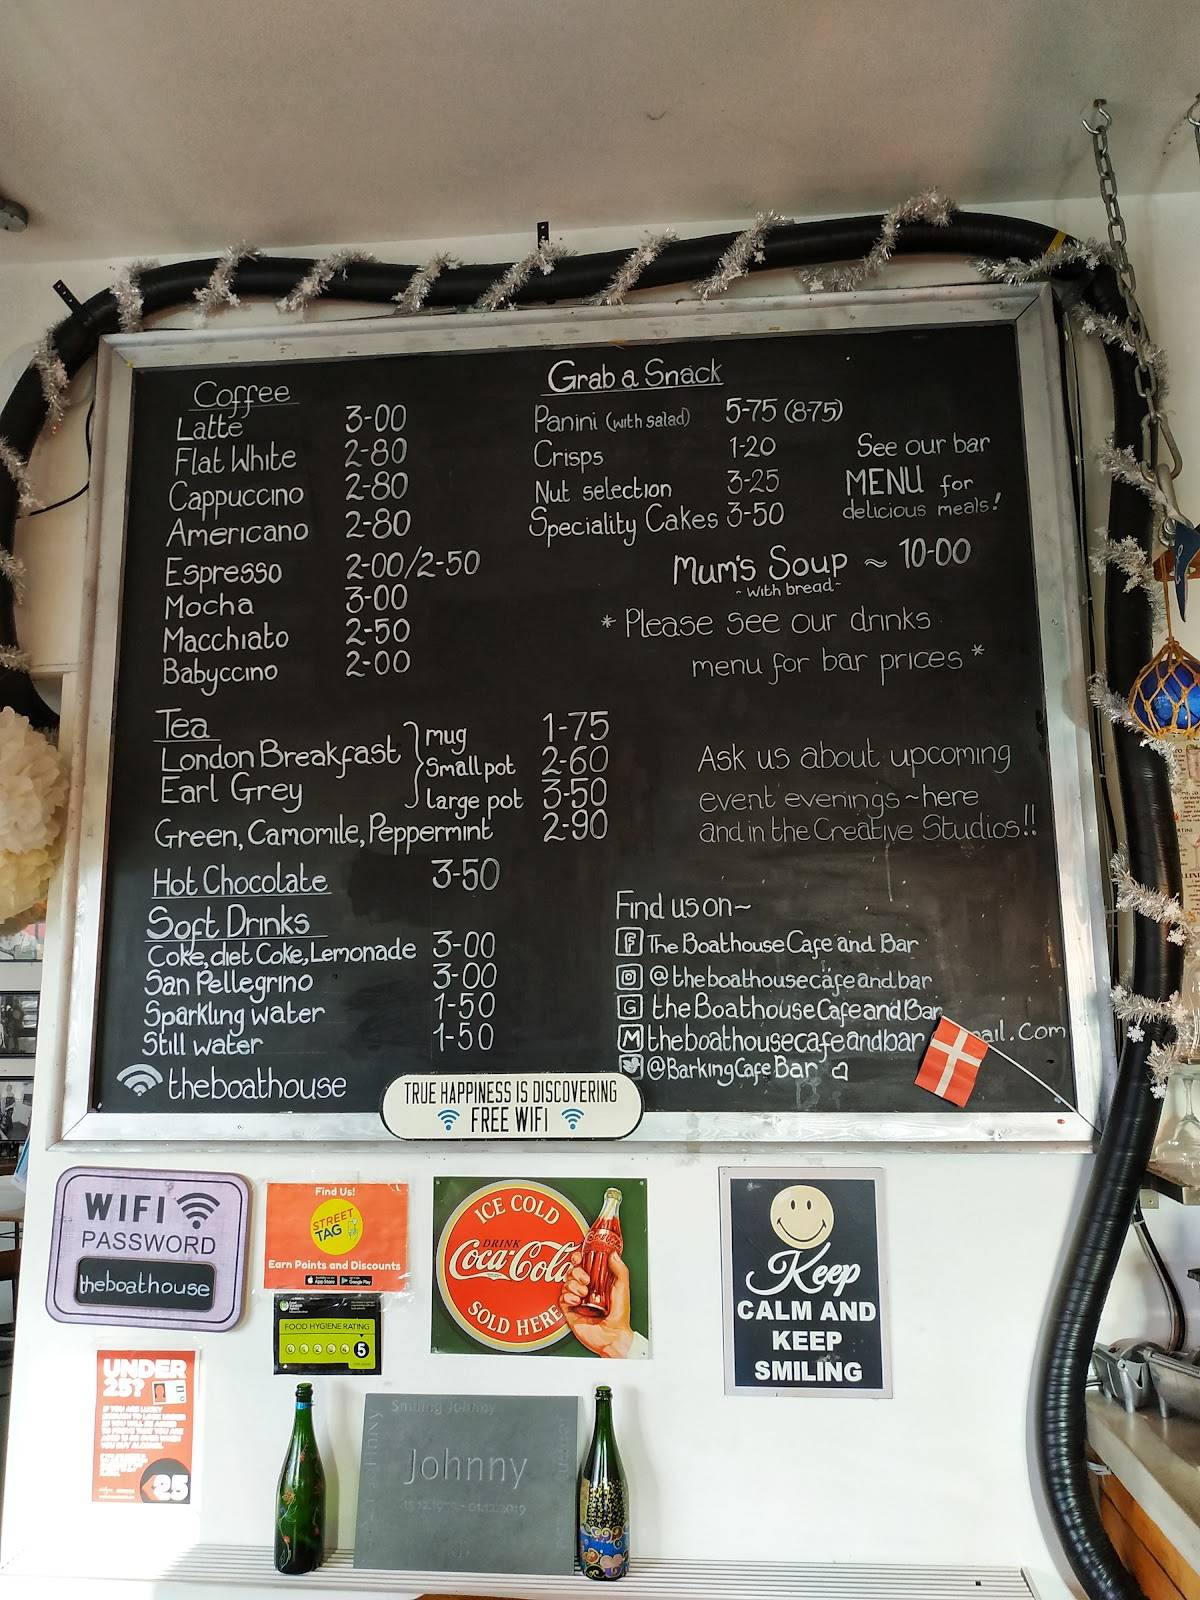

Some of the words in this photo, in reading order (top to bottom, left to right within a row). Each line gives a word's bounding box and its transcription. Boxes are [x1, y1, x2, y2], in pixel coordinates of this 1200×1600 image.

[548, 360, 615, 392] Grab
[621, 369, 639, 388] a
[644, 358, 723, 386] Snack
[193, 381, 291, 418] Coffee
[726, 397, 778, 423] 5-75
[784, 399, 843, 423] (8-75)
[176, 414, 244, 441] Latte
[345, 404, 407, 432] 3-00
[535, 404, 598, 433] Panini
[606, 411, 643, 432] (with
[646, 407, 690, 428] salad)
[176, 446, 224, 476] Flat
[232, 441, 297, 472] White
[345, 438, 407, 468] 2-80
[534, 439, 604, 473] Crisps
[730, 436, 776, 458] 1-20
[857, 432, 898, 458] See
[905, 436, 947, 456] our
[953, 432, 990, 453] bar
[345, 471, 408, 501] 2-80
[535, 480, 570, 503] Nut
[583, 476, 672, 500] selection
[727, 469, 779, 494] 3-25
[845, 465, 924, 496] MENU
[939, 474, 973, 497] for
[169, 481, 304, 521] Cappuccino
[726, 501, 784, 528] 3-50
[843, 499, 926, 521] delicious
[937, 492, 1002, 517] meals!
[166, 518, 309, 547] Americano
[345, 508, 411, 539] 2-80
[529, 506, 636, 547] Speciality
[645, 503, 719, 532] Cakes
[345, 546, 481, 580] 2-00/2-50
[768, 544, 848, 581] Soup
[898, 537, 972, 570] 10-00
[166, 557, 282, 593] Espresso
[747, 584, 782, 598] with
[785, 579, 834, 595] bread
[166, 593, 254, 620] Mocha
[344, 584, 408, 613] 3-00
[163, 621, 289, 653] Macchiato
[345, 618, 410, 645] 2-50
[626, 607, 713, 638] Please
[727, 609, 781, 635] see
[791, 610, 837, 635] our
[850, 606, 931, 632] drinks
[162, 657, 278, 696] Babyccino
[345, 651, 410, 678] 2-00
[692, 653, 763, 677] menu
[768, 653, 810, 685] for
[822, 647, 867, 672] bar
[880, 650, 963, 685] prices
[155, 708, 210, 740] Tea
[542, 711, 609, 743] 1-75
[426, 726, 467, 755] mug
[161, 743, 254, 772] London
[260, 735, 402, 779] Breakfast
[426, 757, 482, 778] Small
[485, 756, 516, 782] pot
[541, 745, 609, 776] 2-60
[698, 743, 746, 773] Ask
[756, 746, 790, 771] us
[800, 738, 880, 769] about
[890, 743, 1011, 778] upcoming
[161, 772, 218, 805] Earl
[230, 772, 302, 813] Grey
[426, 787, 480, 820] large
[487, 788, 524, 817] pot
[541, 777, 607, 809] 3-50
[699, 785, 776, 813] event
[155, 818, 244, 851] Green,
[247, 814, 365, 849] Camomile,
[368, 813, 493, 855] Peppermint
[541, 809, 608, 843] 2-90
[699, 819, 745, 844] and
[748, 821, 765, 842] in
[771, 816, 811, 843] the
[813, 816, 914, 841] Creative
[152, 866, 198, 896] Hot
[202, 861, 328, 895] Chocolate
[431, 857, 501, 891] 3-50
[616, 890, 663, 921] Find
[671, 897, 700, 919] us
[147, 905, 220, 954] Soft
[227, 903, 310, 938] Drinks
[646, 933, 679, 954] The
[682, 932, 785, 955] Boathouse
[836, 932, 876, 953] and
[880, 931, 918, 954] Bar
[147, 943, 209, 969] Coke,
[211, 941, 253, 966] diet
[256, 942, 309, 967] Coke,
[310, 937, 417, 963] Lemonade
[432, 930, 496, 959] 3-00
[144, 969, 190, 996] San
[196, 969, 314, 1004] Pellegrino
[432, 961, 497, 990] 3-00
[143, 1000, 245, 1036] Sparkling
[252, 1001, 326, 1025] water
[432, 992, 496, 1020] 1-50
[142, 1031, 185, 1057] Still
[193, 1034, 263, 1057] water
[432, 1022, 495, 1053] 1-50
[168, 1066, 348, 1100] theboathouse
[404, 1082, 437, 1104] TRUE
[441, 1081, 511, 1104] HAPPINESS
[516, 1081, 527, 1103] IS
[534, 1080, 617, 1103] DISCOVERING
[471, 1107, 509, 1133] FREE
[515, 1107, 548, 1132] WIFI
[315, 1187, 337, 1196] Find
[340, 1188, 355, 1196] Us!
[85, 1192, 165, 1224] WIFI
[313, 1208, 354, 1230] STREET
[474, 1197, 506, 1224] ICE
[510, 1195, 560, 1225] COLD
[81, 1231, 216, 1254] PASSWORD
[315, 1224, 342, 1242] TAG
[483, 1239, 521, 1248] DRINK
[268, 1260, 292, 1269] Earn
[295, 1260, 326, 1269] Points
[329, 1261, 348, 1269] and
[351, 1261, 400, 1270] Discounts
[449, 1239, 583, 1282] Coca-Cola
[745, 1241, 861, 1297] Keep
[79, 1270, 211, 1297] theboathouse
[468, 1300, 510, 1334] SOLD
[517, 1304, 563, 1336] HERE
[737, 1301, 813, 1321] CALM
[819, 1301, 877, 1322] AND
[357, 1343, 366, 1356] 5
[772, 1330, 843, 1352] KEEP
[103, 1359, 187, 1378] UNDER
[754, 1361, 863, 1382] SMILING
[103, 1378, 144, 1398] 25?
[404, 1448, 528, 1489] Johnny
